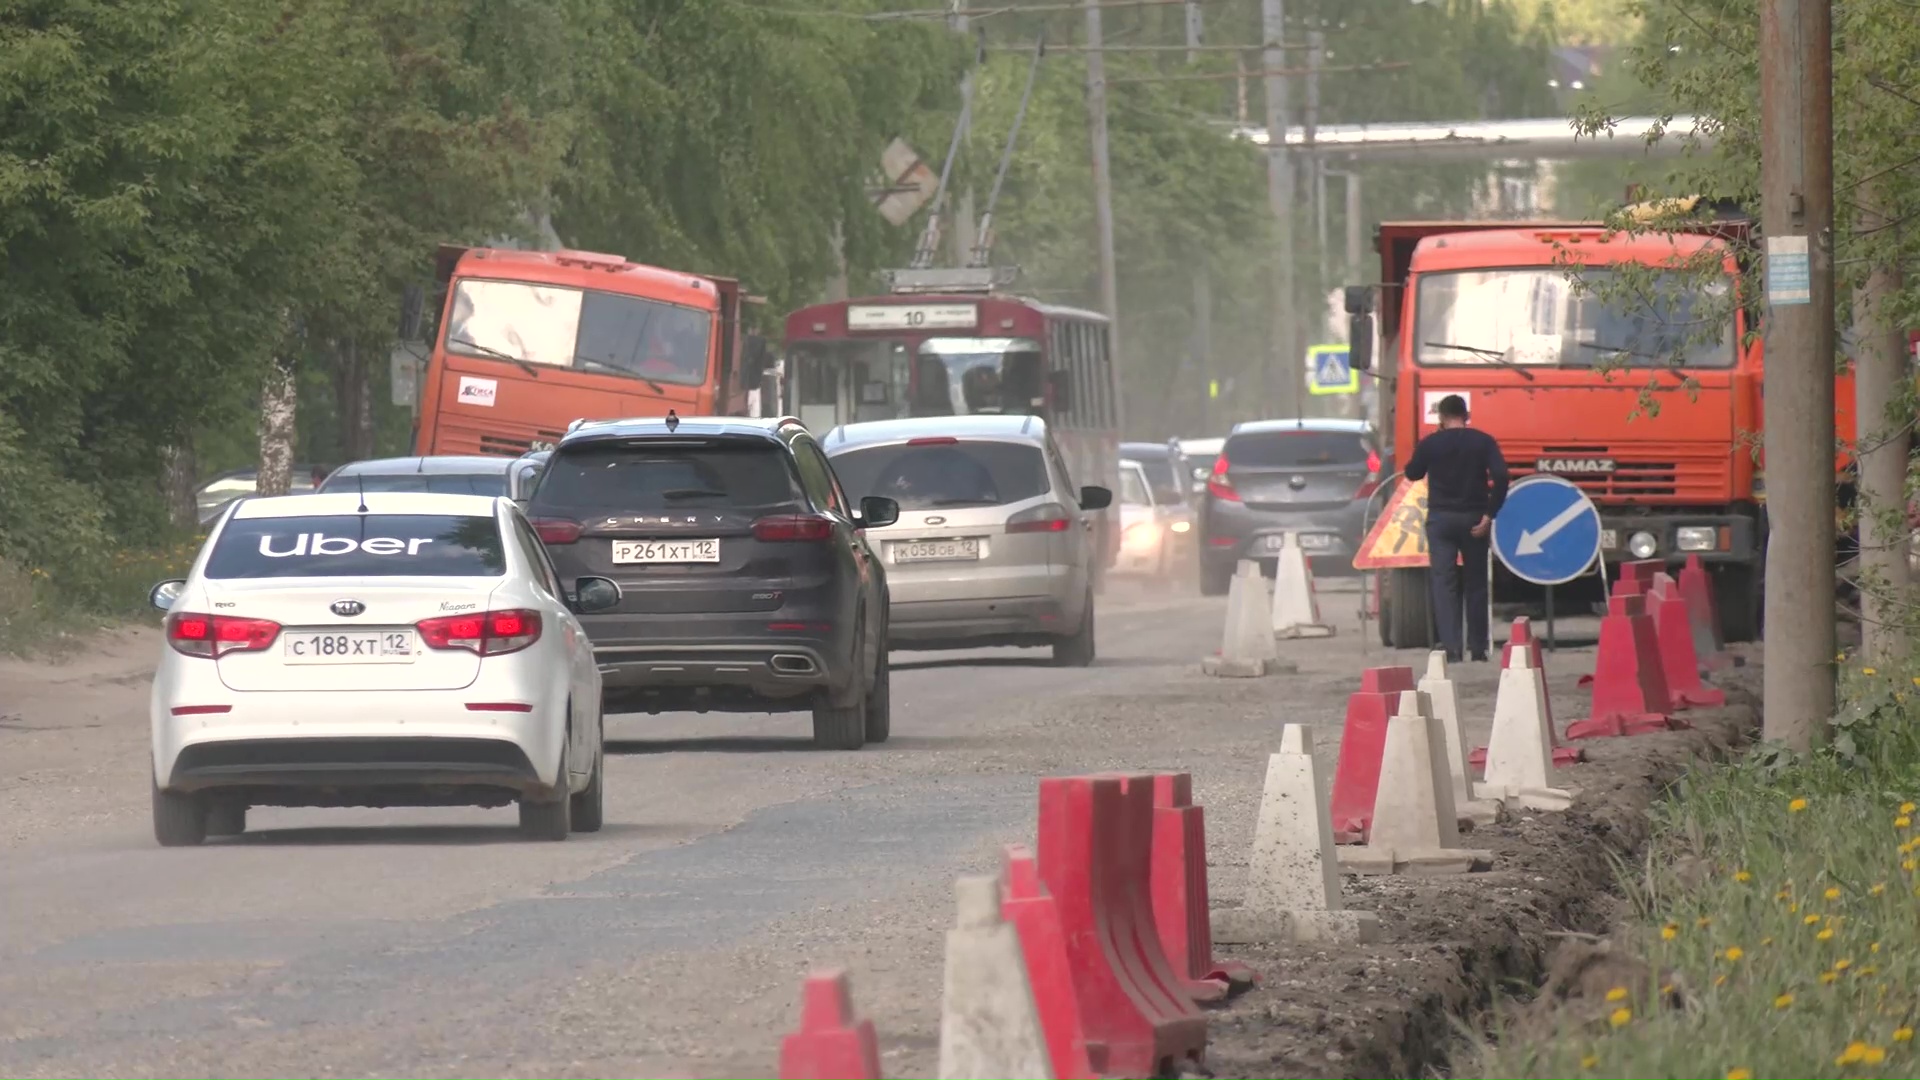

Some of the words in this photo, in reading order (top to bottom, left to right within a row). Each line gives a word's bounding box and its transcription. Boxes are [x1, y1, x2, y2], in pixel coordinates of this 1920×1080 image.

[905, 311, 925, 325] 10
[1537, 459, 1614, 472] KAMAZ
[607, 515, 723, 524] CHERY
[695, 542, 712, 554] 12
[335, 602, 361, 614] KIA
[385, 634, 405, 649] 12
